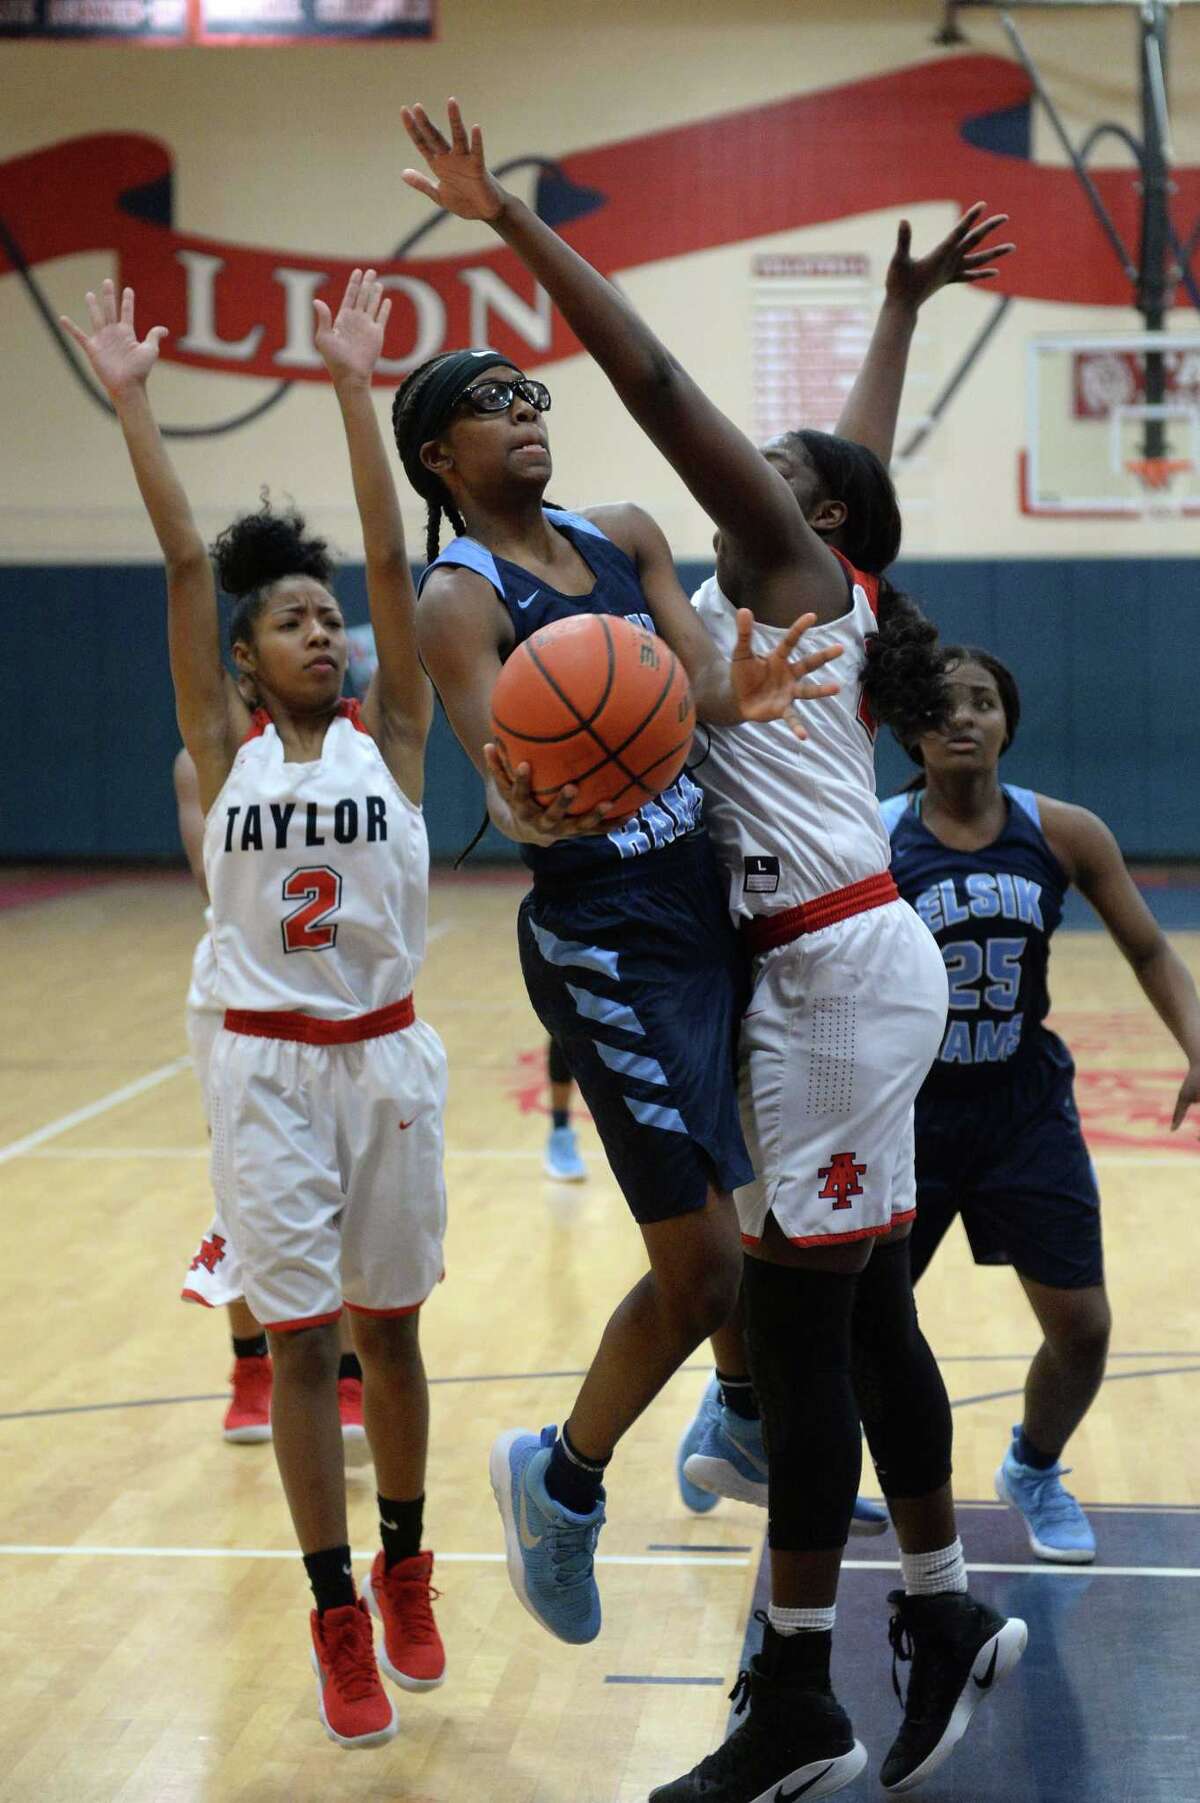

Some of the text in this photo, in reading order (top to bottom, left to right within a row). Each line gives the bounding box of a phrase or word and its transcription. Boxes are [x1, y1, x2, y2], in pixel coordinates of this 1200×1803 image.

[224, 796, 388, 852] TAYLOR
[757, 859, 767, 871] L
[281, 865, 342, 954] 2
[915, 872, 1044, 934] ELSIK
[939, 937, 1028, 1012] 25
